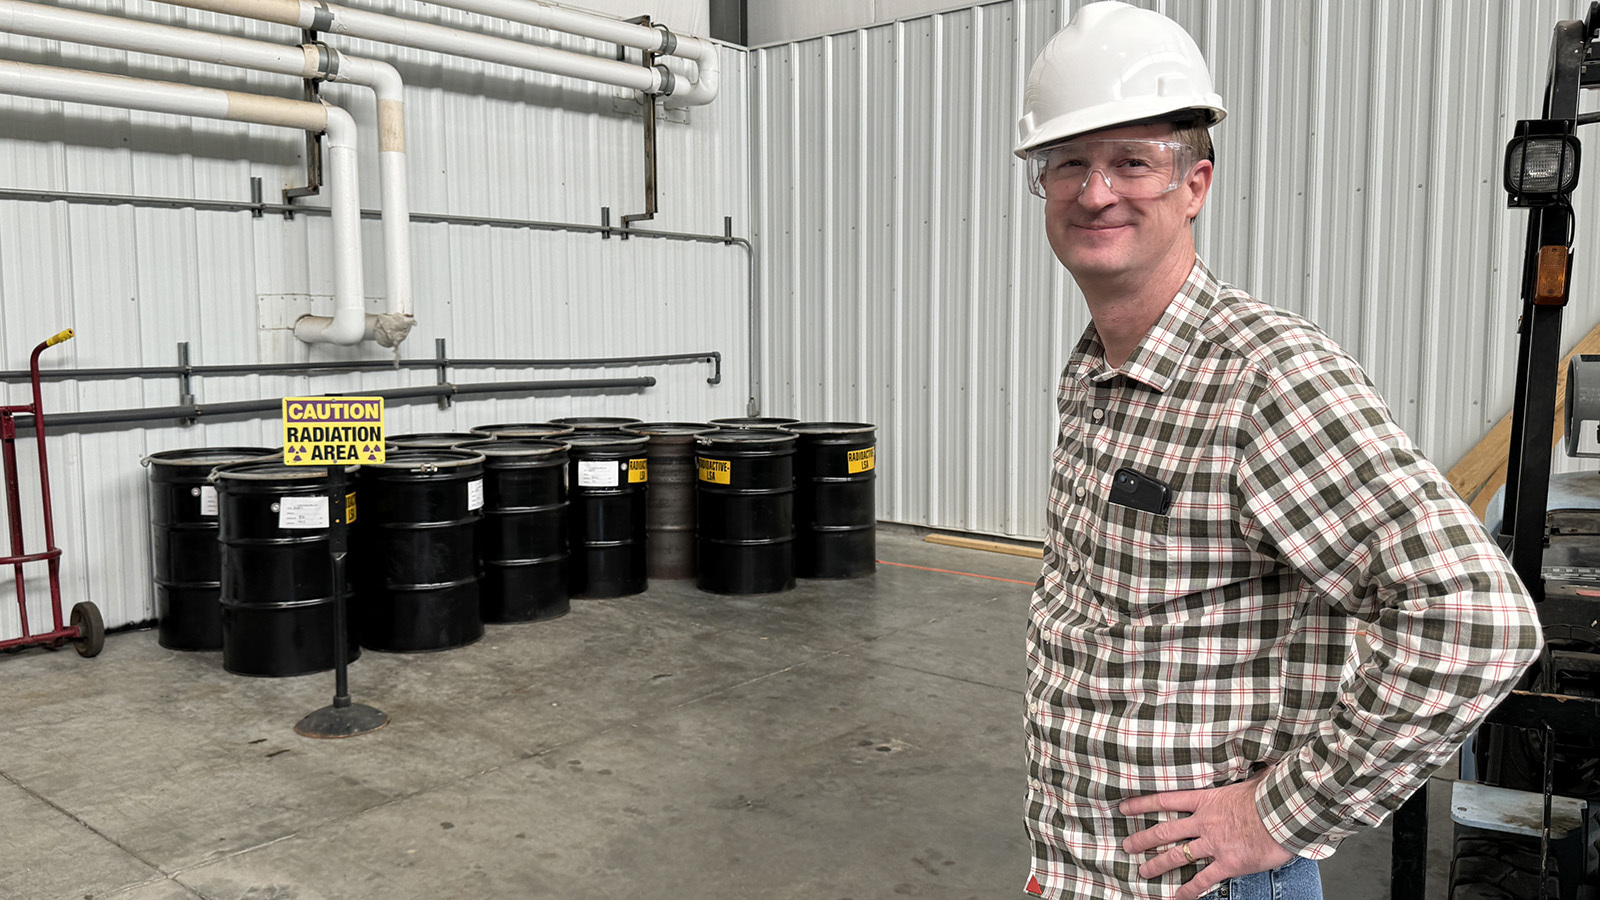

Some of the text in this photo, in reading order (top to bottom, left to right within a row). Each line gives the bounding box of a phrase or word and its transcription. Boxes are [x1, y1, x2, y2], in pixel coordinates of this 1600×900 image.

[288, 402, 379, 420] CAUTION
[287, 426, 381, 442] RADIATION
[311, 445, 359, 460] AREA
[861, 460, 869, 470] LSA
[707, 470, 715, 480] LSA
